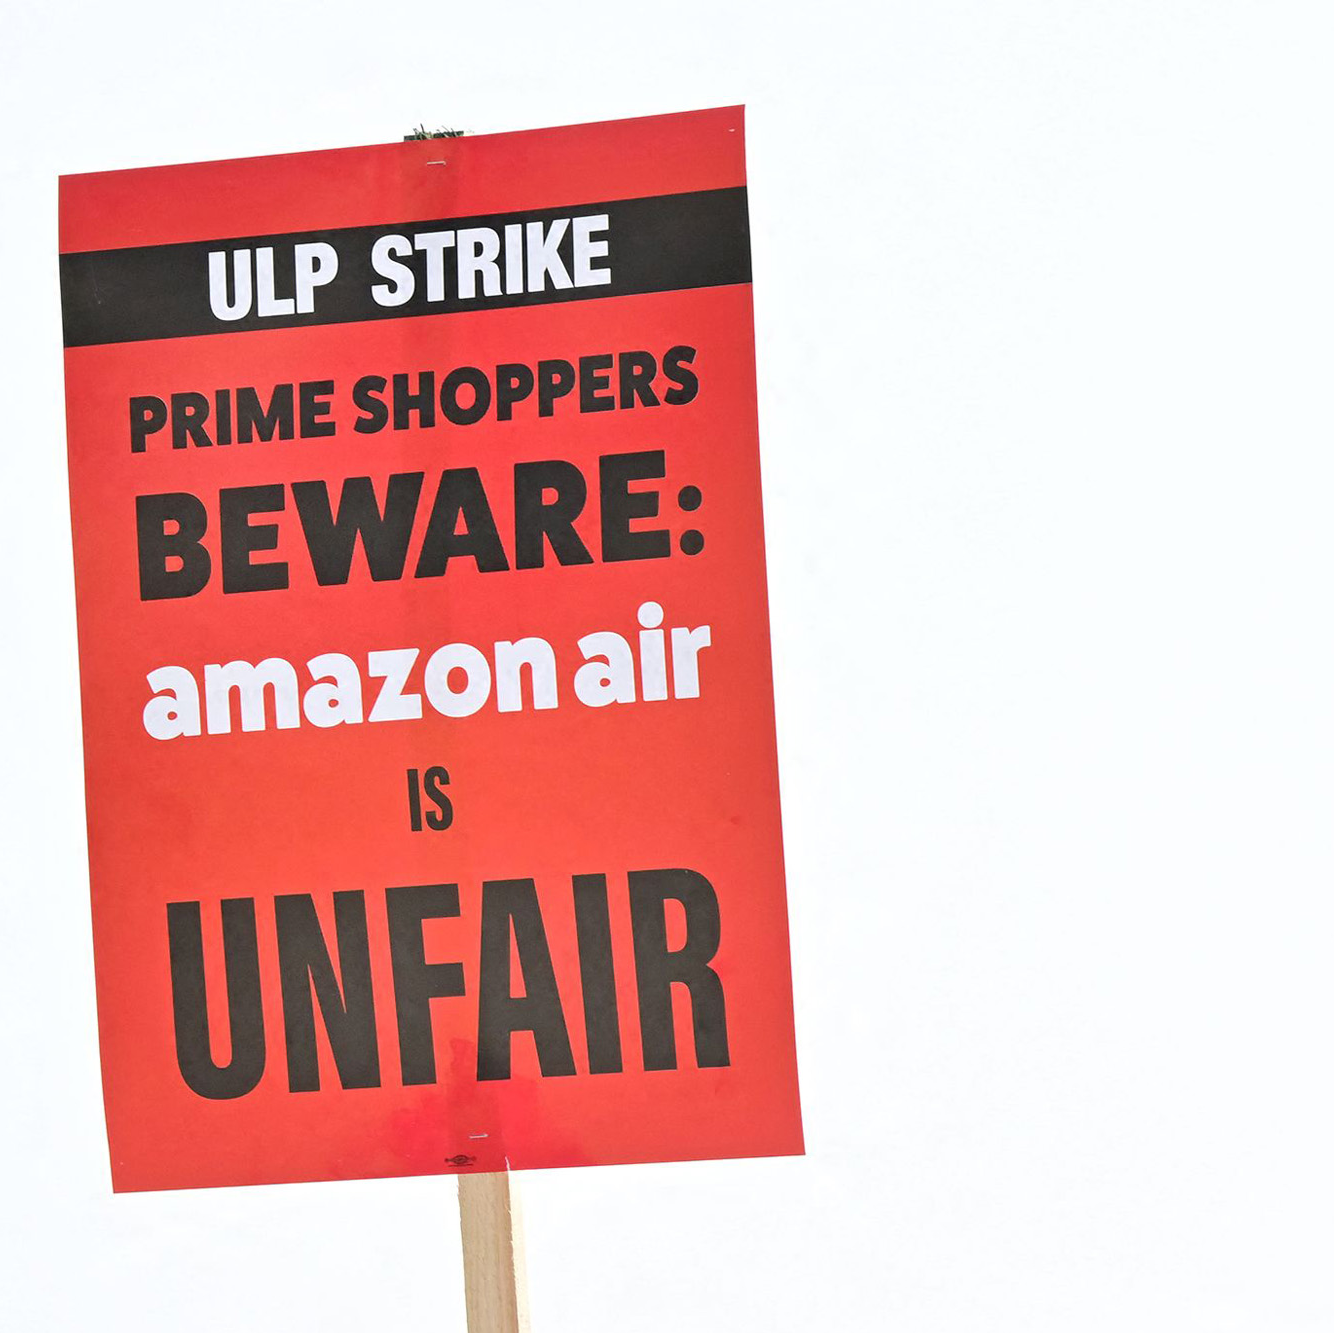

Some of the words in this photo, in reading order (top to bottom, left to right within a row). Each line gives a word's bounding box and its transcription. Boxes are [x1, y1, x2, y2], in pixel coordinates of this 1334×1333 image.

[208, 242, 339, 322] ULP
[370, 213, 612, 308] STRIKE
[129, 379, 337, 453] PRIME
[352, 345, 700, 435] SHOPPERS
[134, 449, 706, 602] BEWARE:
[142, 636, 559, 741] amazon
[573, 600, 712, 708] air
[406, 765, 455, 833] IS
[166, 867, 731, 1101] UNFAIR
